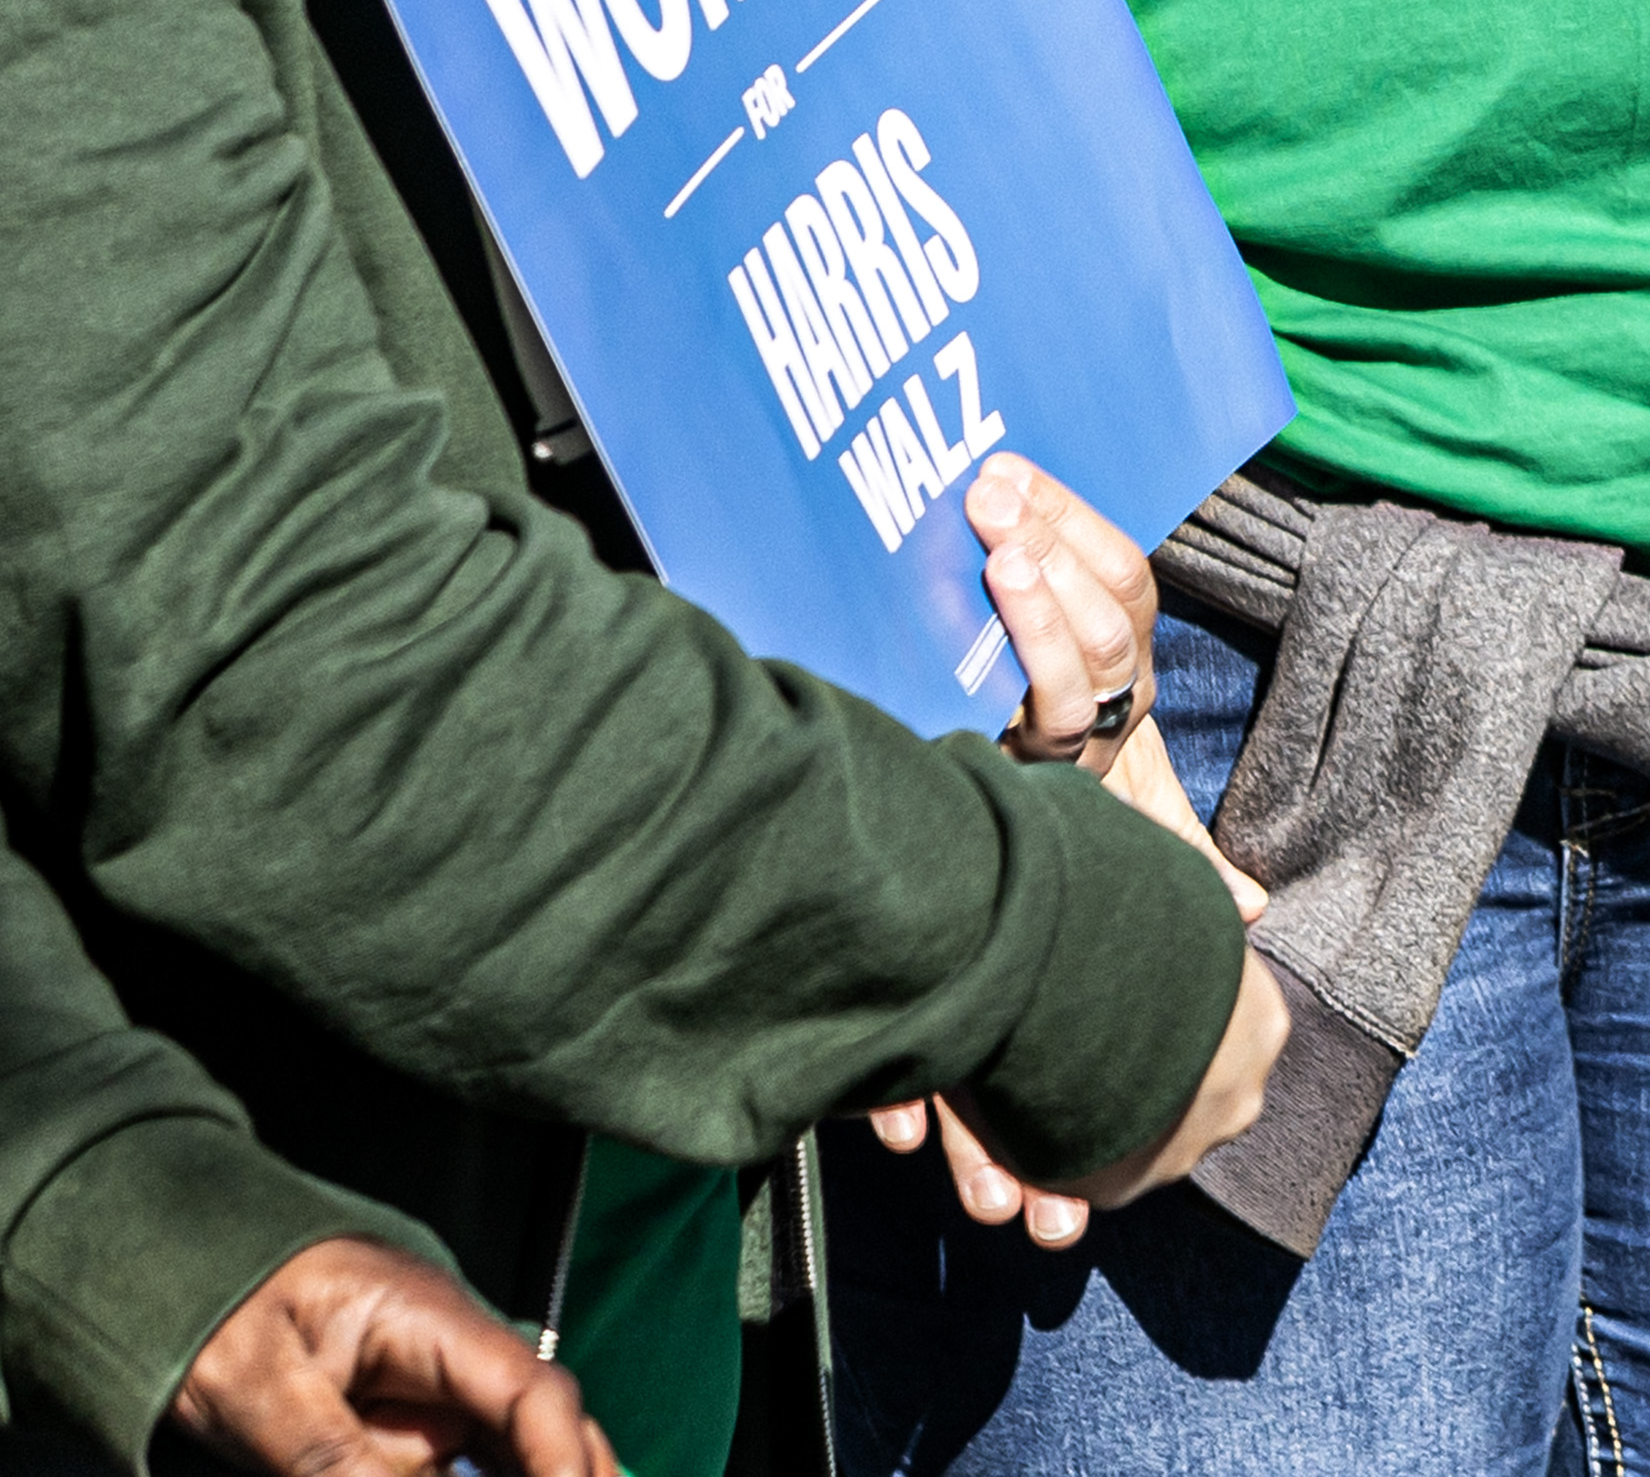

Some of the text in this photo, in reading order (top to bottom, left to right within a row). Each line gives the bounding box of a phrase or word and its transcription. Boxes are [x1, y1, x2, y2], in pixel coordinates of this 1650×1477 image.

[742, 64, 795, 139] FOR
[728, 108, 980, 460] HARRIS
[838, 331, 1006, 553] WALZ
